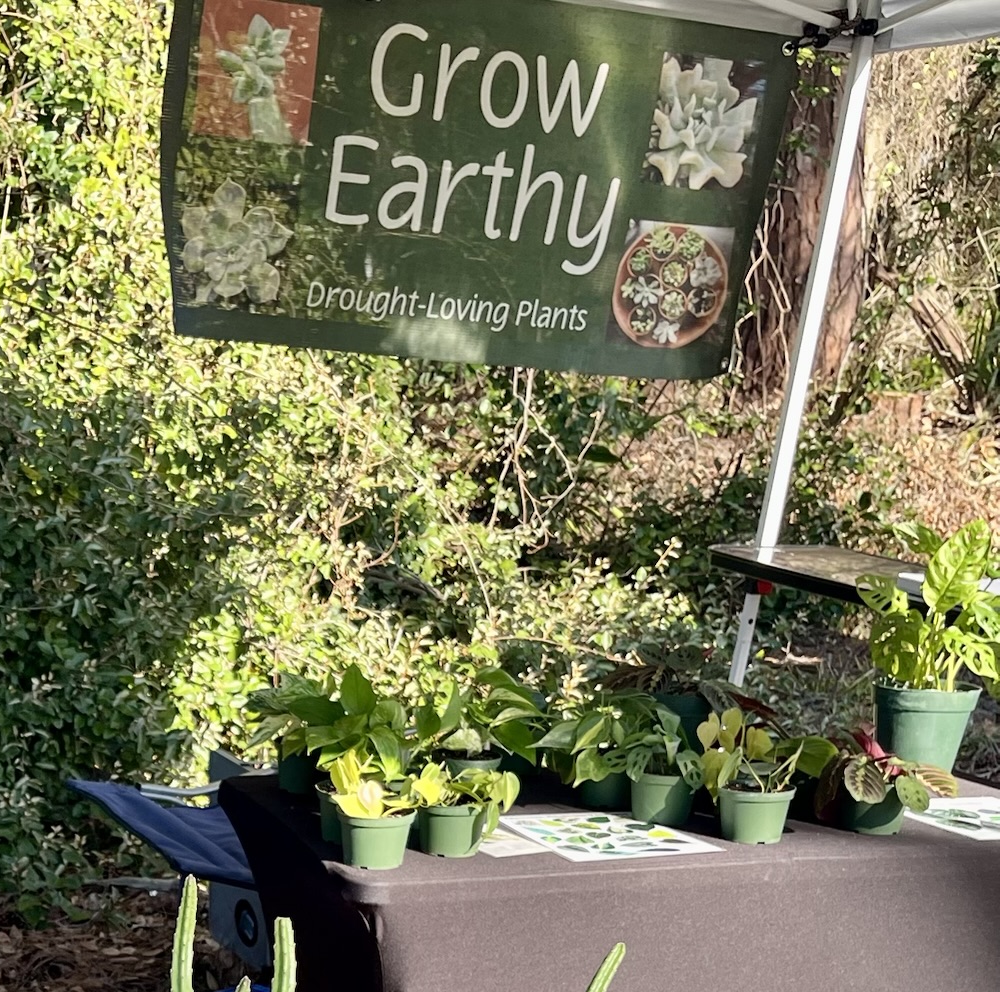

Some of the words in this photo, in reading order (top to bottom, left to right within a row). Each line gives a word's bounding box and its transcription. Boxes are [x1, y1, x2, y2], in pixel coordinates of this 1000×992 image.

[371, 22, 610, 137] Grow
[326, 134, 621, 276] Earthy
[306, 280, 511, 332] Drought-Loving
[515, 298, 588, 332] Plants
